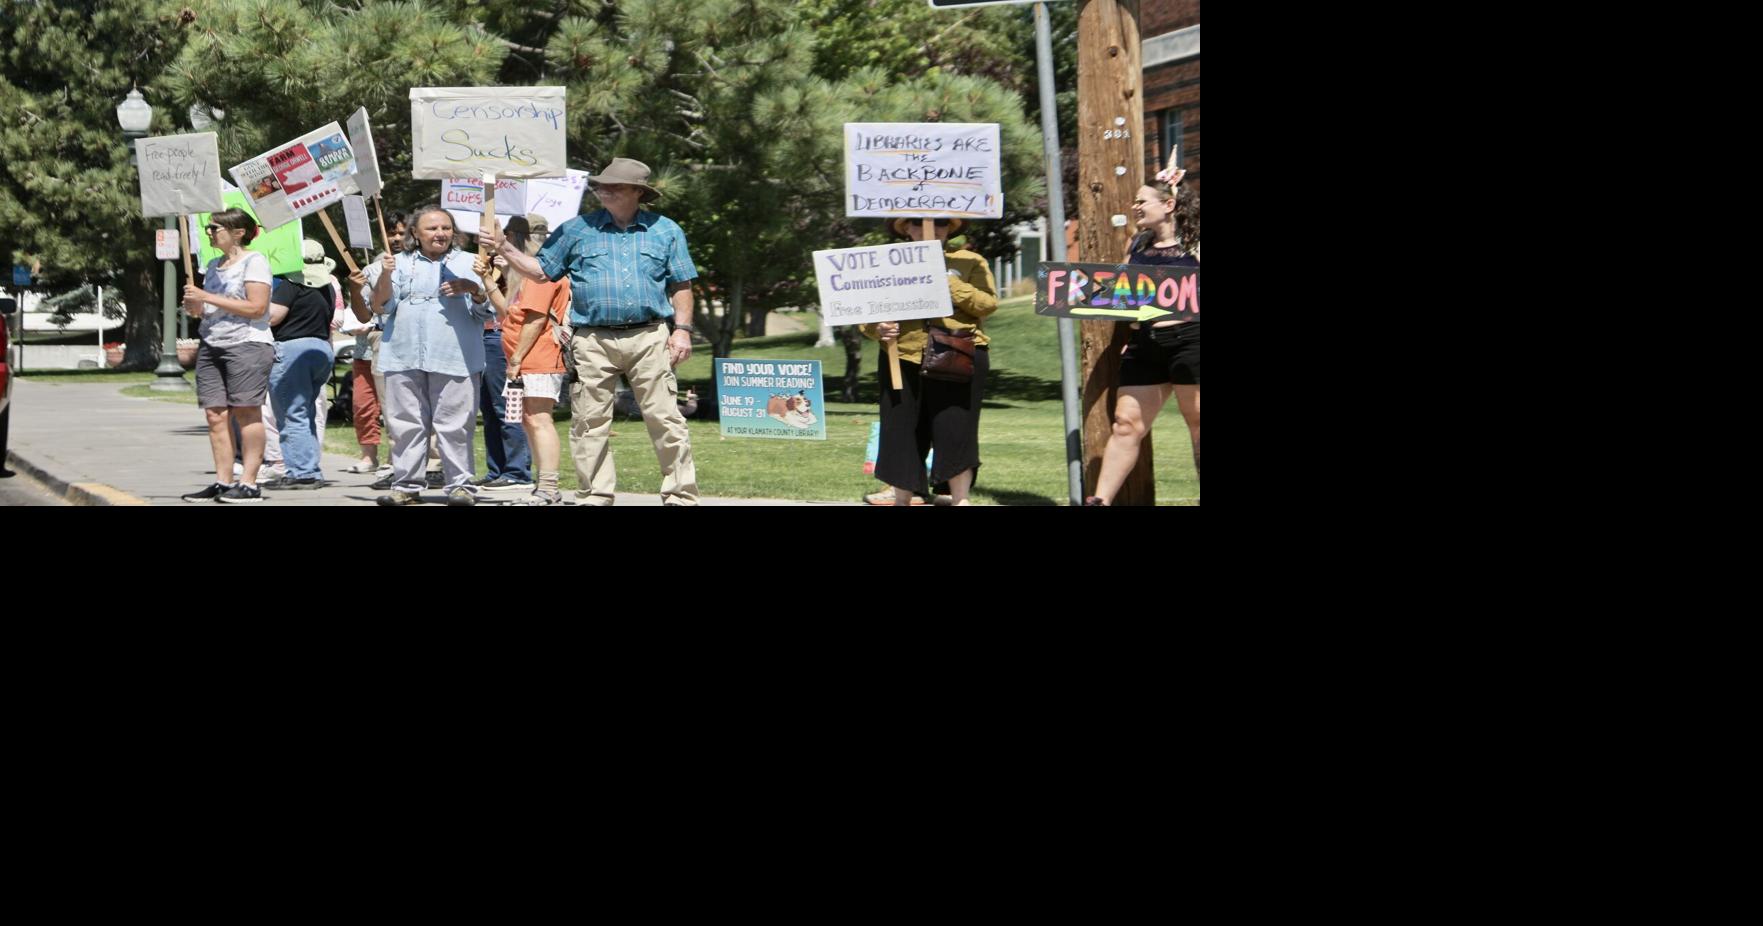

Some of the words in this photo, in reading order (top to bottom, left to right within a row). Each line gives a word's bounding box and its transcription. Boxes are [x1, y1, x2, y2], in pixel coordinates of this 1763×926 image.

[433, 102, 563, 130] Censorship
[441, 129, 537, 165] Sucks
[856, 132, 942, 151] LIBRARIES
[952, 137, 992, 152] ARE
[145, 143, 163, 160] Free
[268, 149, 296, 166] FARM
[857, 164, 988, 182] BACKBONE
[826, 251, 880, 271] VOTE
[888, 246, 929, 265] OUT
[830, 274, 933, 291] Commissioners
[1048, 269, 1199, 313] FREADOM
[722, 362, 744, 374] FIND
[746, 363, 775, 375] YOUR
[777, 363, 812, 376] VOICE!
[723, 376, 740, 386] JOIN
[742, 376, 774, 387] SUMMER
[776, 377, 815, 388] READING!
[721, 395, 742, 405] JUNE
[744, 396, 754, 405] 19
[722, 407, 753, 417] AUGUST
[756, 409, 766, 417] 31
